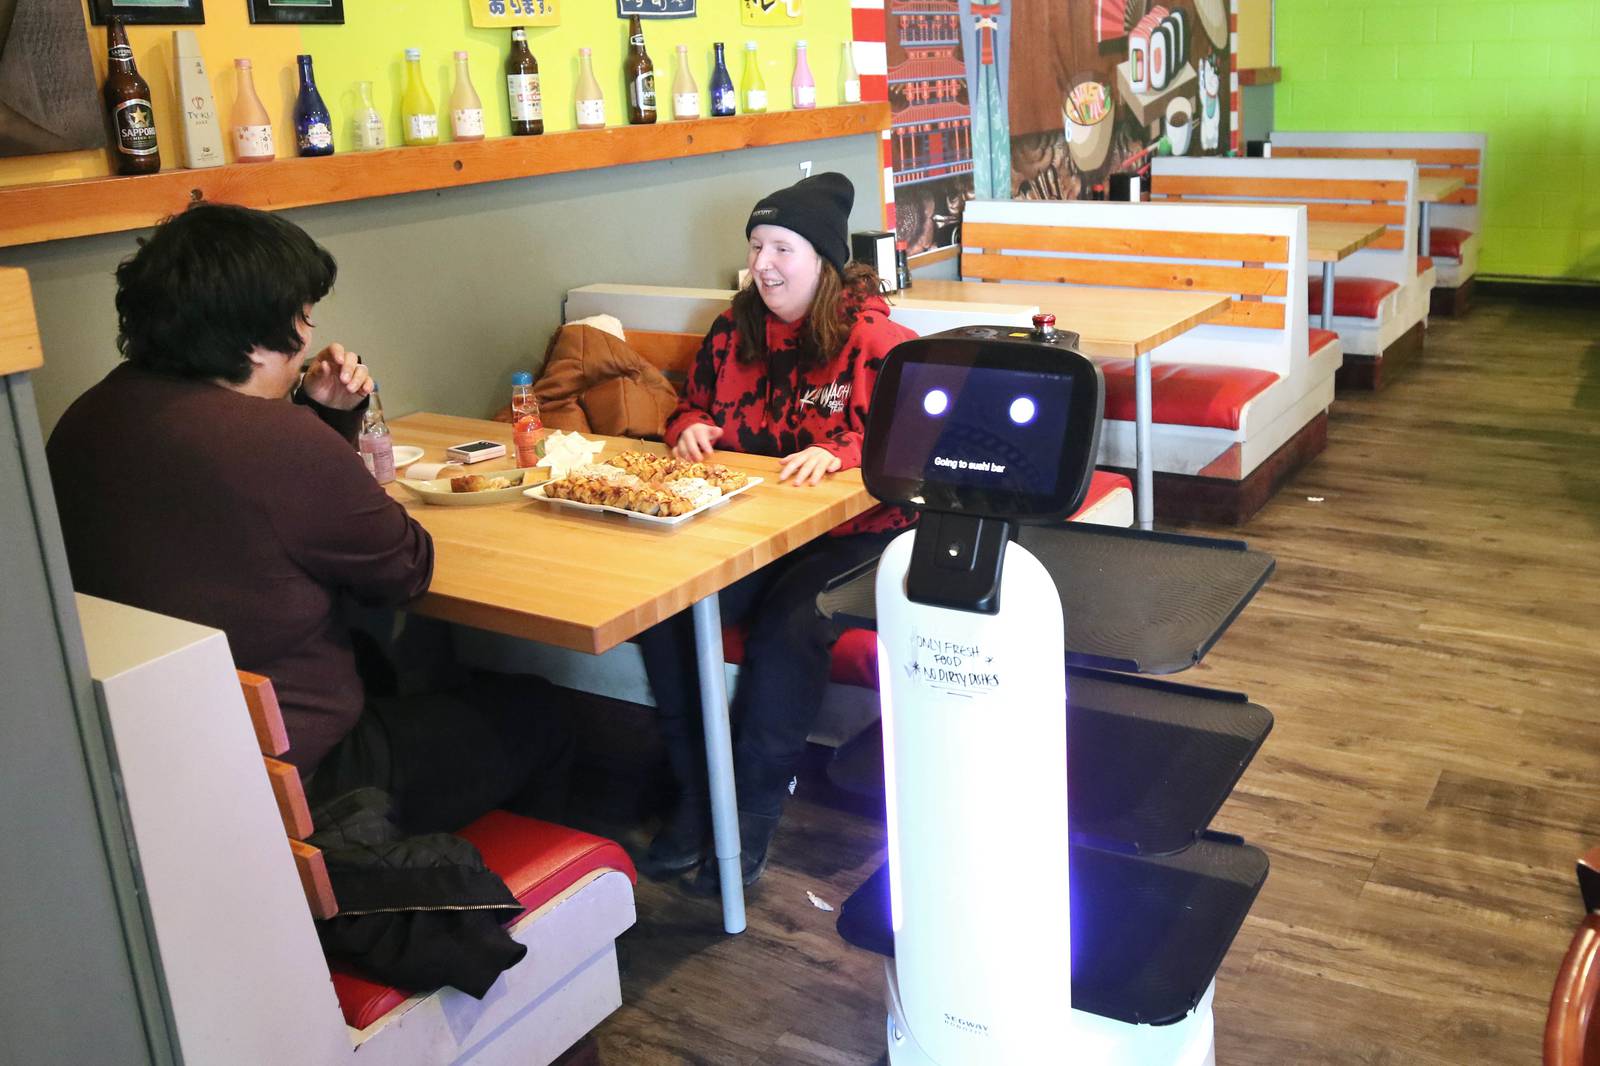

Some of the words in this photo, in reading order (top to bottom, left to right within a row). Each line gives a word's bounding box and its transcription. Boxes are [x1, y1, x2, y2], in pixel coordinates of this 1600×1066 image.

[799, 160, 812, 178] 7
[934, 456, 958, 470] Going
[958, 459, 968, 469] to
[968, 461, 991, 472] sushi
[991, 462, 1006, 473] bar
[915, 634, 942, 654] ONLY
[944, 641, 980, 658] FRESH
[933, 653, 962, 667] FOOD
[923, 666, 937, 681] NO
[938, 670, 967, 687] DIRTY
